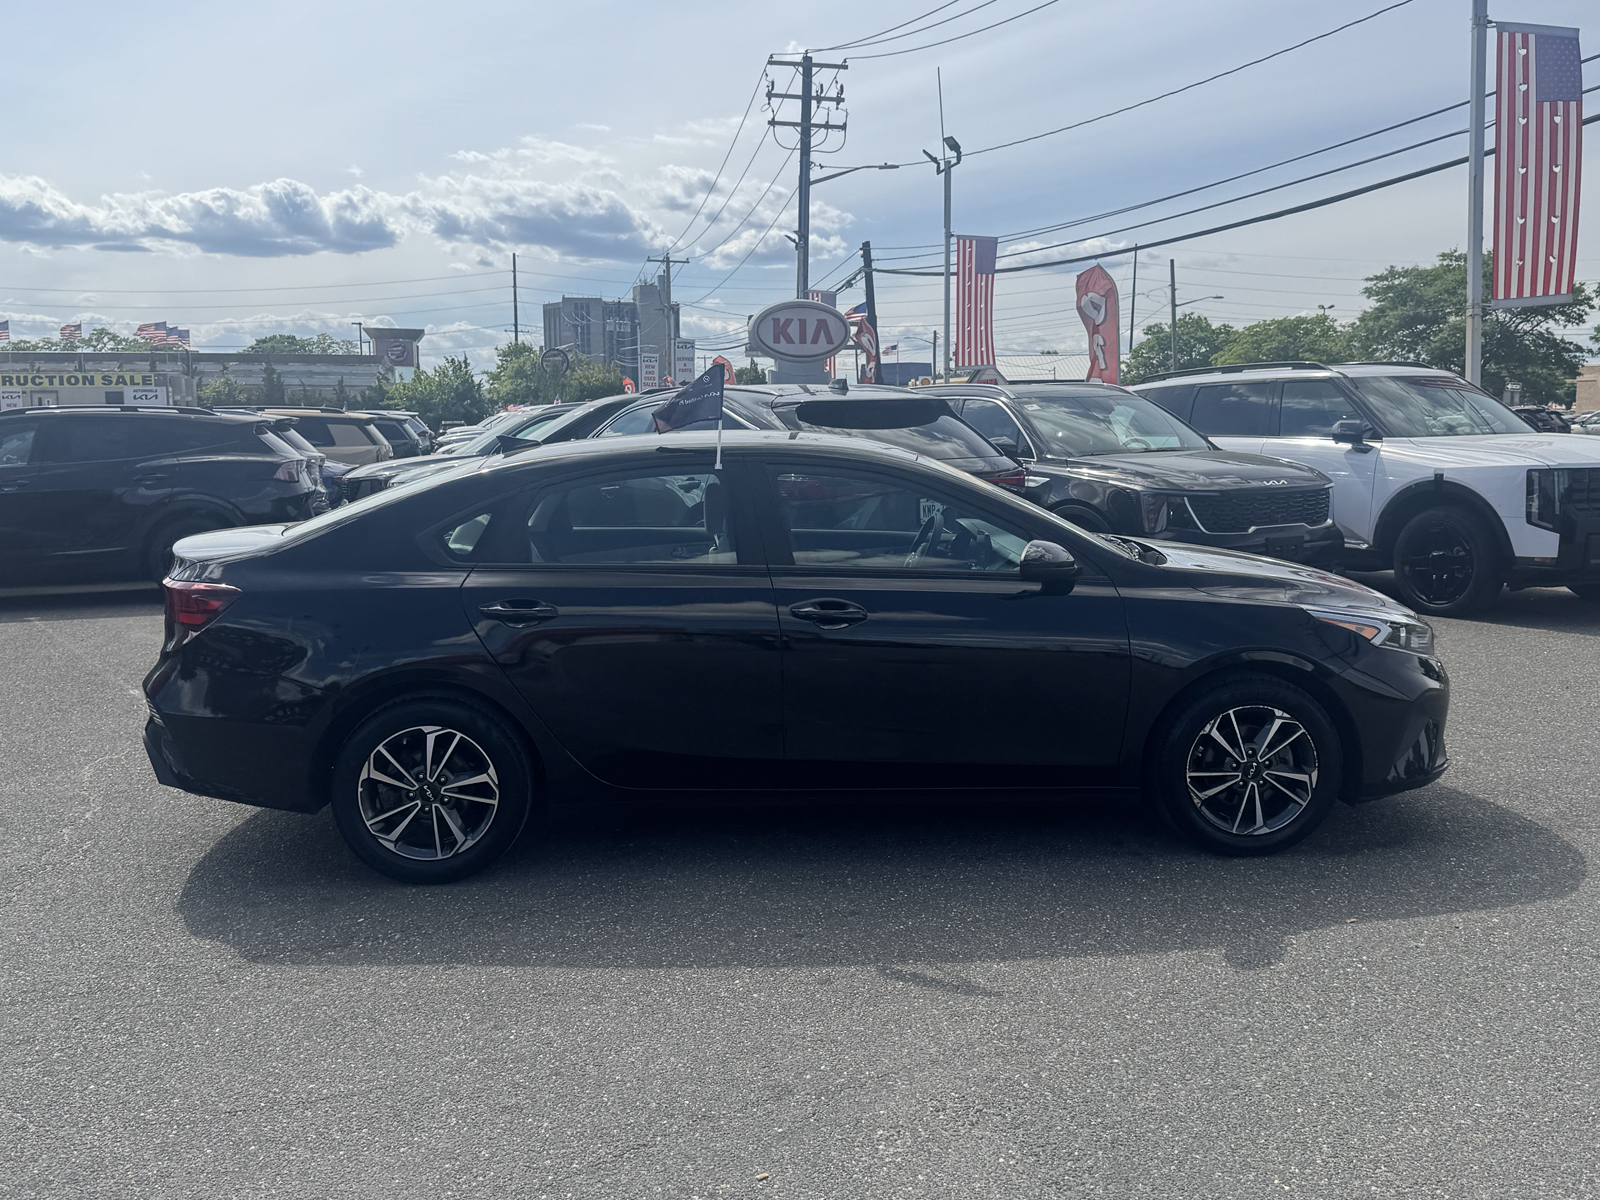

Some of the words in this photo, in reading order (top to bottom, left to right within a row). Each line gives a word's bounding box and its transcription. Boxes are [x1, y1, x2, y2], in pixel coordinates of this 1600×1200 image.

[772, 318, 834, 344] KIA
[1, 374, 94, 386] RUCTION
[101, 374, 153, 386] SALE
